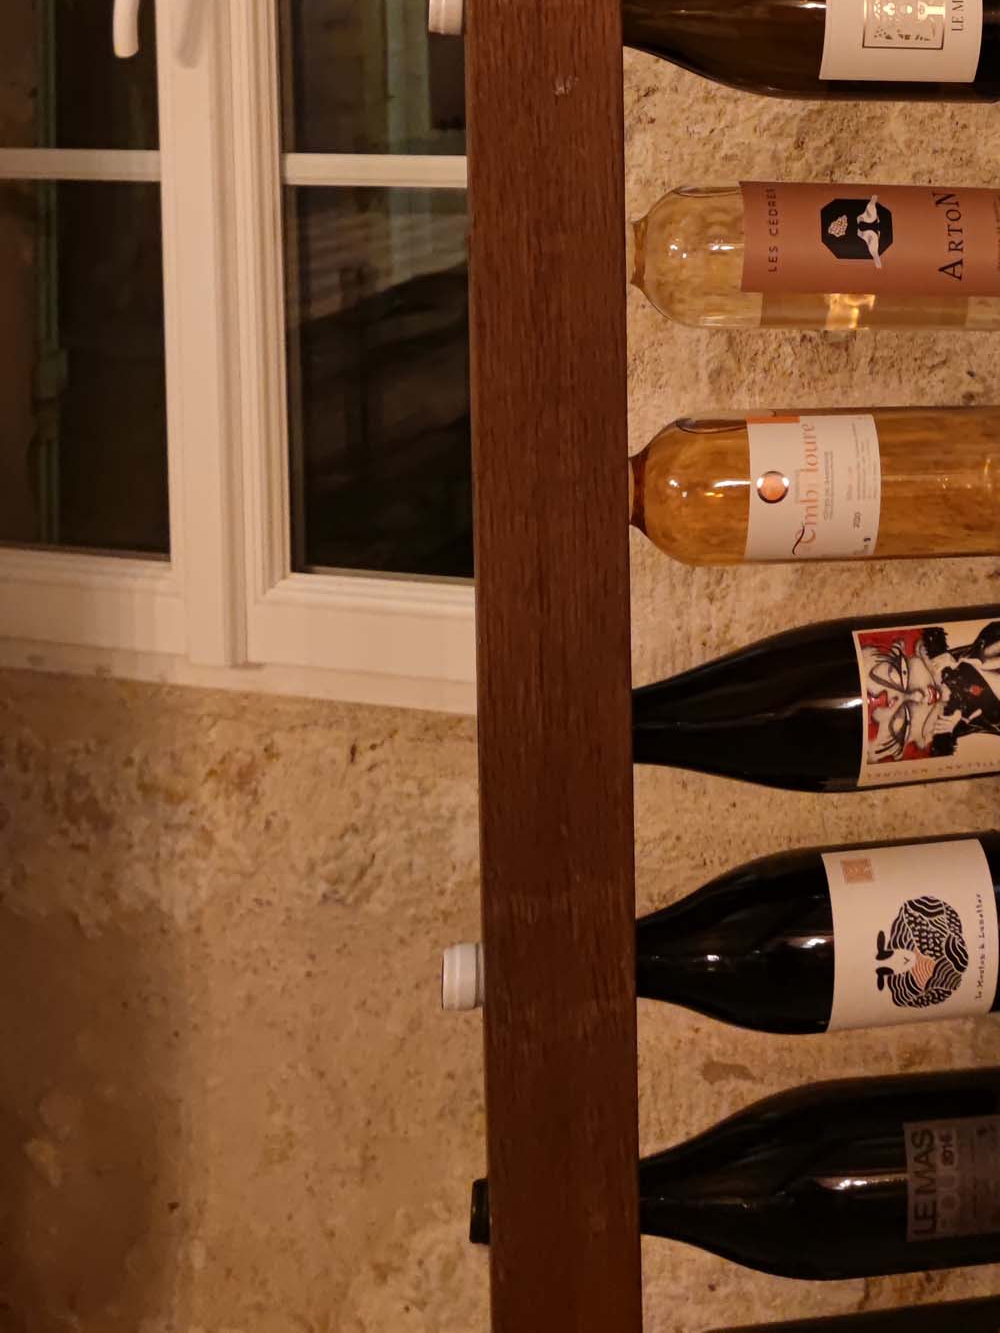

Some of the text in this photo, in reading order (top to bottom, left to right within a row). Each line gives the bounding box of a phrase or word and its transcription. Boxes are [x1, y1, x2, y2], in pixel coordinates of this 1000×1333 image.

[951, 16, 964, 32] LE
[767, 245, 778, 273] LES
[931, 191, 964, 282] ARTON
[910, 1129, 937, 1236] LE MAS
